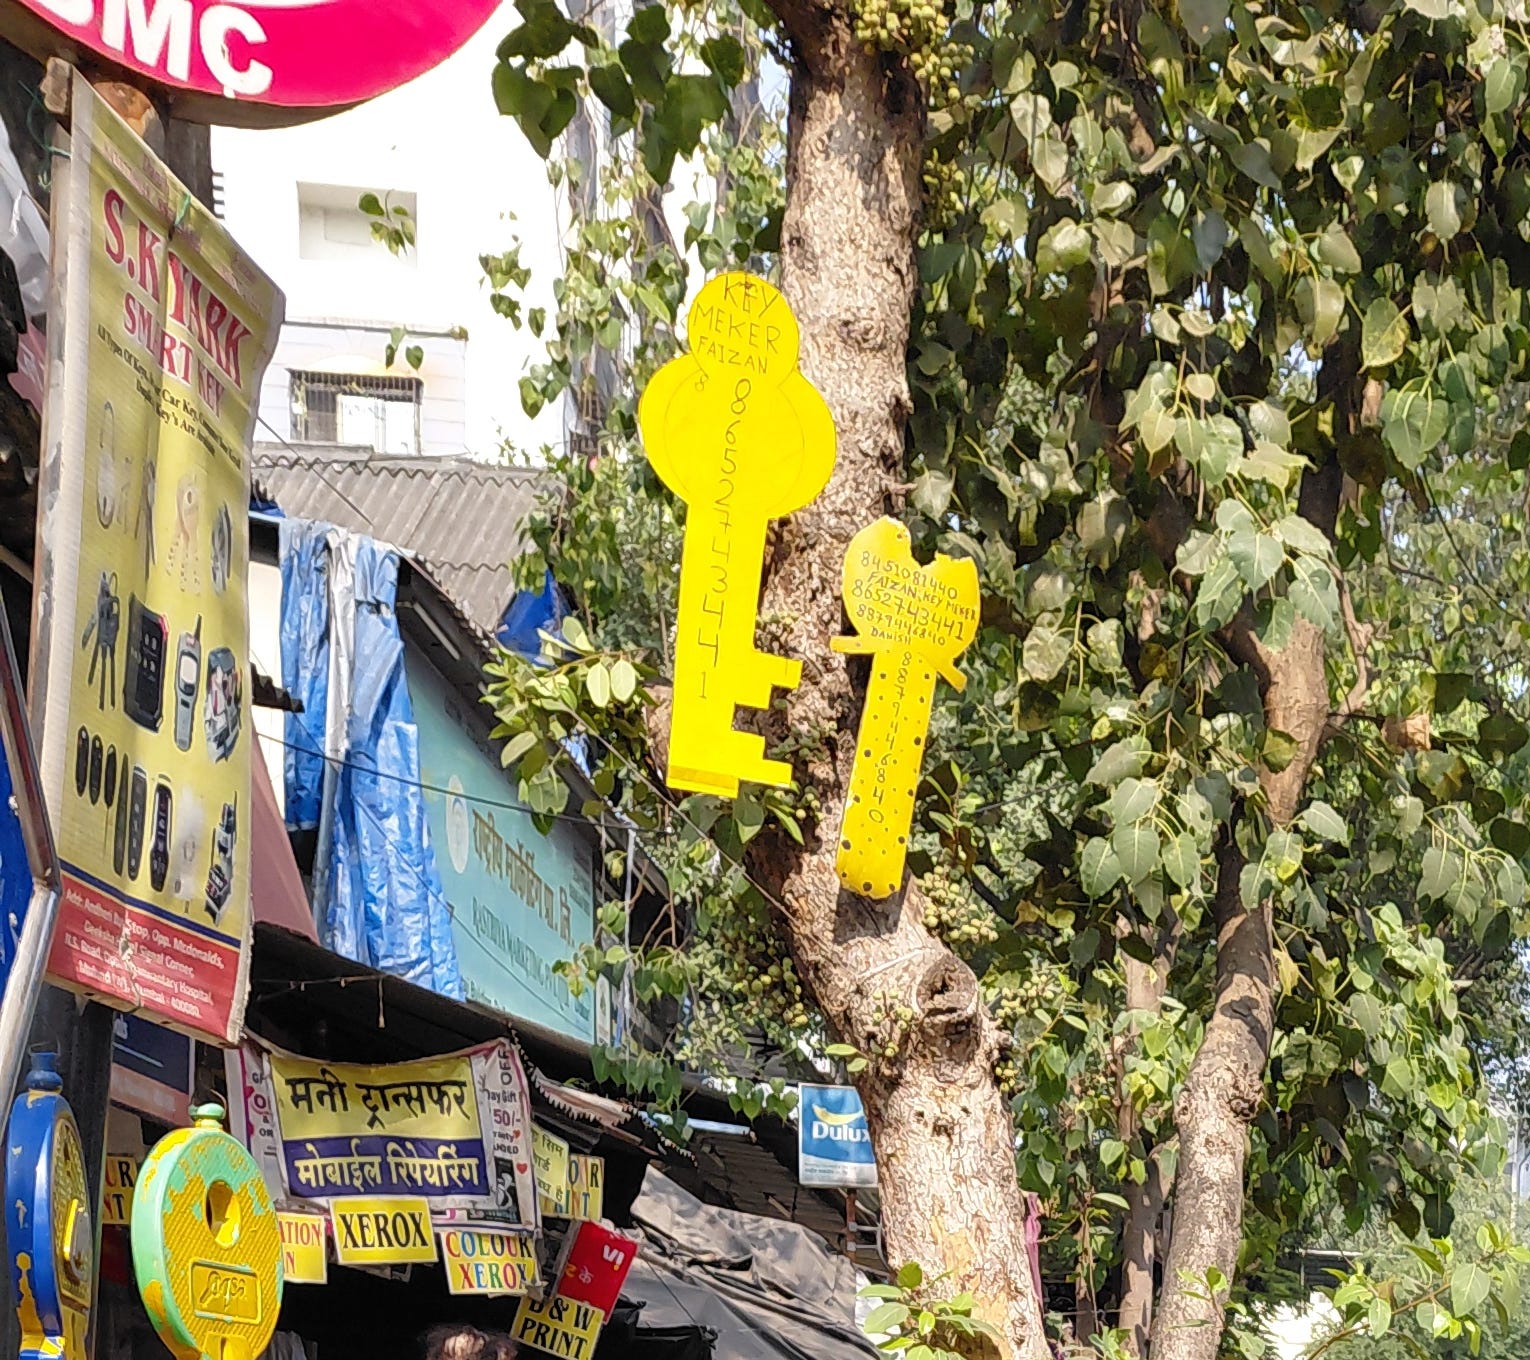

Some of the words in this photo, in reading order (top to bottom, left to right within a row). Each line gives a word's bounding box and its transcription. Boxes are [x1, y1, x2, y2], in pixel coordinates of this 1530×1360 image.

[36, 0, 273, 96] MC
[724, 275, 779, 318] KEY
[693, 303, 781, 354] MEKER
[697, 336, 768, 374] FAIZAN
[285, 1068, 349, 1114] मनी
[355, 1079, 470, 1130] ट्रान्सफर
[812, 1121, 871, 1143] Dulux
[294, 1138, 382, 1192] मोबाईल
[340, 1211, 429, 1249] XEROX
[446, 1231, 534, 1260] COLOUR
[459, 1262, 527, 1290] XEROX
[548, 1298, 567, 1322] &
[573, 1306, 594, 1331] W
[518, 1319, 588, 1360] PRINT
